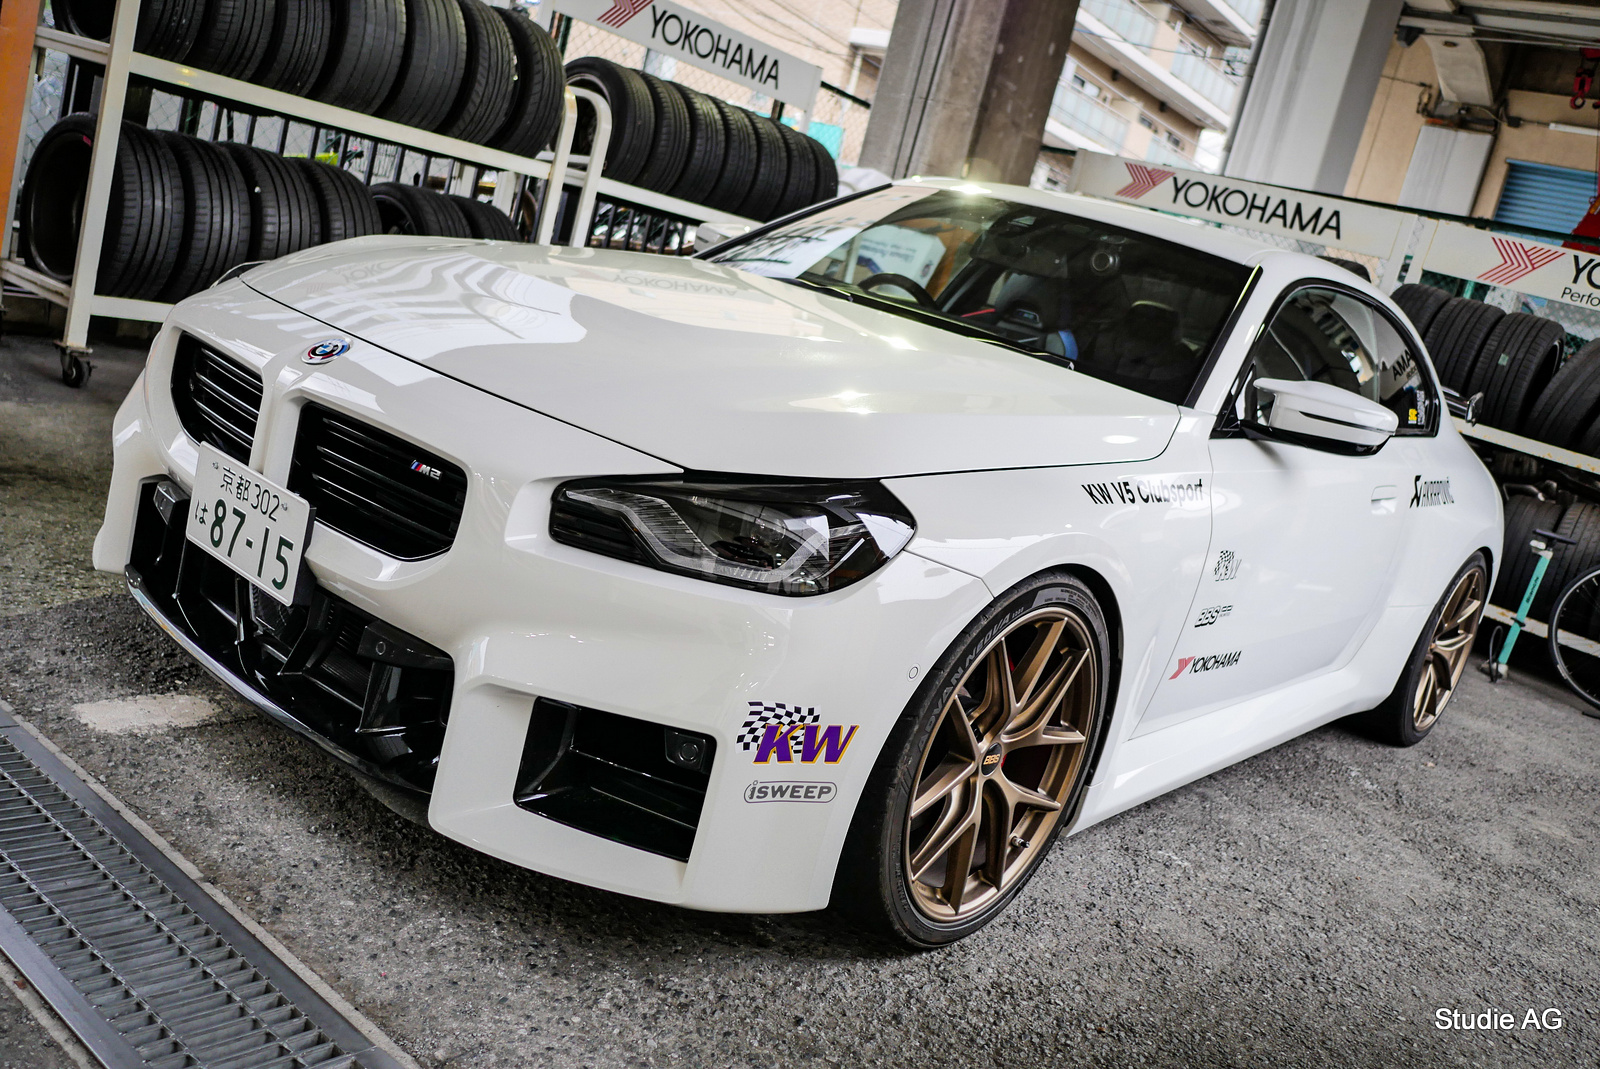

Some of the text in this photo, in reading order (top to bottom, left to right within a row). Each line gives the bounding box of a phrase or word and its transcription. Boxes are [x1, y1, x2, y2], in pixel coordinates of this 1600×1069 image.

[651, 4, 780, 90] YOKOHAMA
[1172, 176, 1341, 240] YOKOHAMA
[420, 463, 442, 480] M2
[220, 465, 280, 523] 京都 302
[1081, 478, 1203, 507] KW V5 Clubsport
[195, 499, 294, 590] は 87-15
[1194, 605, 1221, 628] BBS
[1189, 650, 1242, 674] YOKOHAMA
[918, 665, 964, 752] ADVAN
[965, 612, 1010, 669] NEOVA
[752, 723, 860, 764] KW
[983, 753, 1000, 765] BBS
[748, 780, 832, 799] iSWEEP
